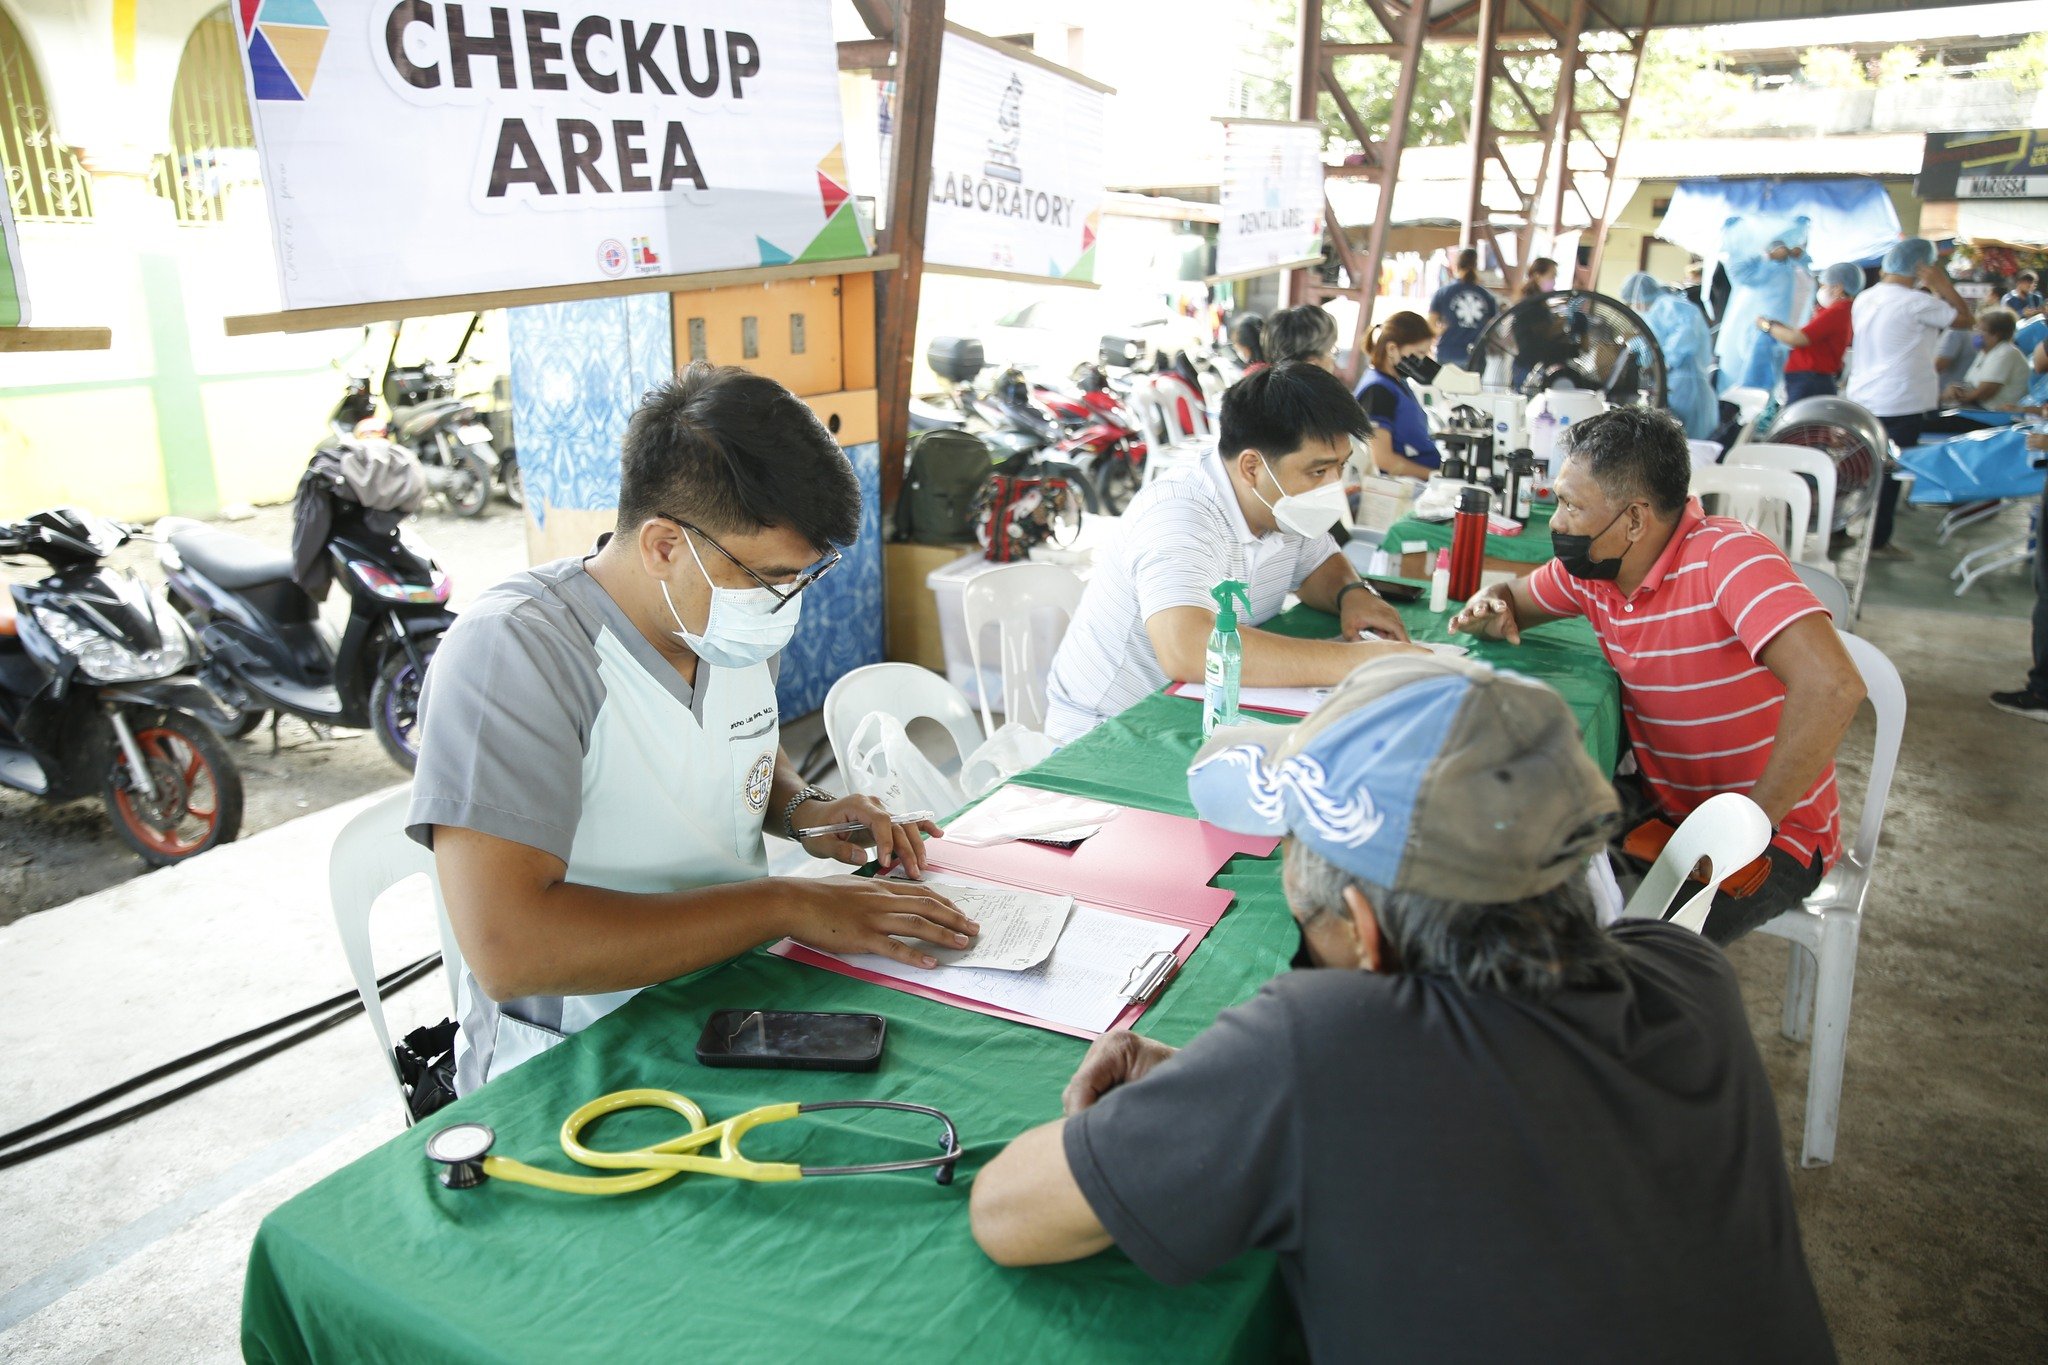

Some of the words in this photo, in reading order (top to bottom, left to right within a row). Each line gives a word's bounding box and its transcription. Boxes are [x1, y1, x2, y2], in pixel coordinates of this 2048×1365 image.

[385, 0, 762, 99] CHECKUP
[486, 117, 709, 198] AREA
[929, 169, 1074, 228] LABORATORY
